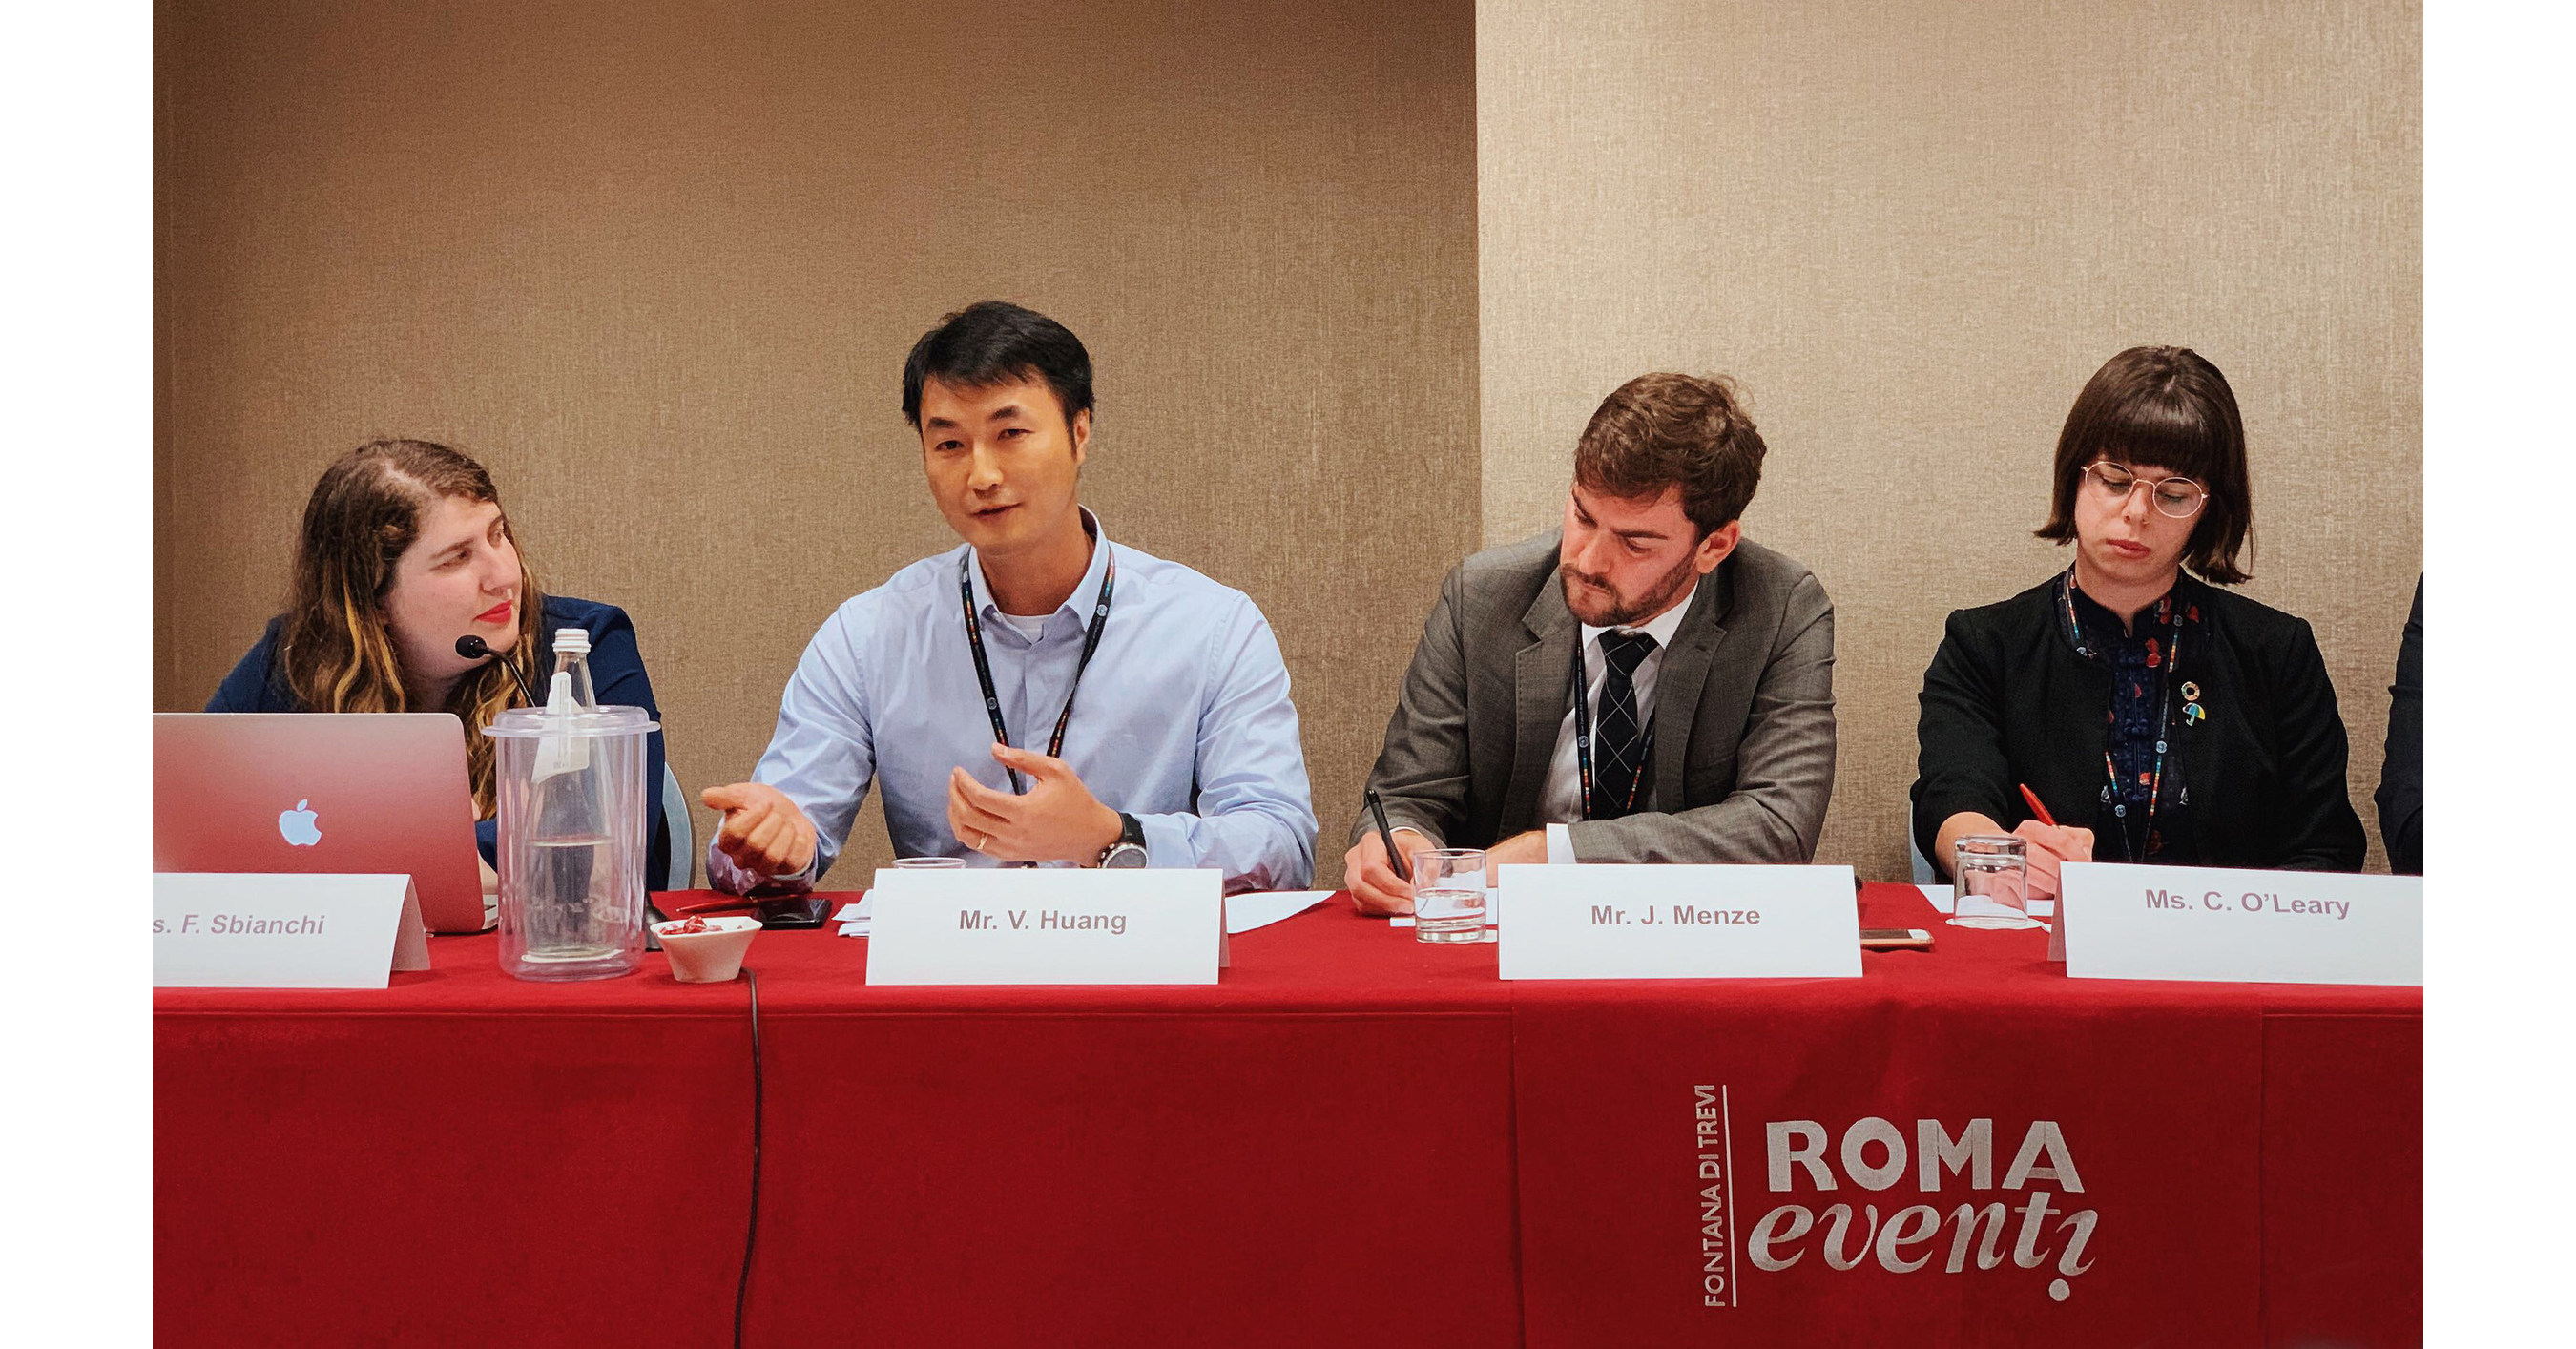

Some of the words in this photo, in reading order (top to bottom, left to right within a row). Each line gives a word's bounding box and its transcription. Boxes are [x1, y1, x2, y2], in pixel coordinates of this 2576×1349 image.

[2145, 889, 2193, 910] Ms.
[2203, 891, 2232, 911] C.
[181, 914, 200, 934] F.
[210, 914, 325, 935] Sbianchi
[959, 909, 998, 930] Mr.
[1008, 909, 1029, 930] V.
[1040, 909, 1127, 935] Huang
[1591, 905, 1631, 925] Mr.
[1640, 905, 1663, 925] J.
[1673, 904, 1761, 925] Menze
[1693, 1084, 1718, 1149] TREVI
[1698, 1153, 1721, 1179] DI
[1765, 1116, 2086, 1193] ROMA
[1700, 1183, 1726, 1307] FONTANA
[1747, 1191, 2099, 1302] eventi
